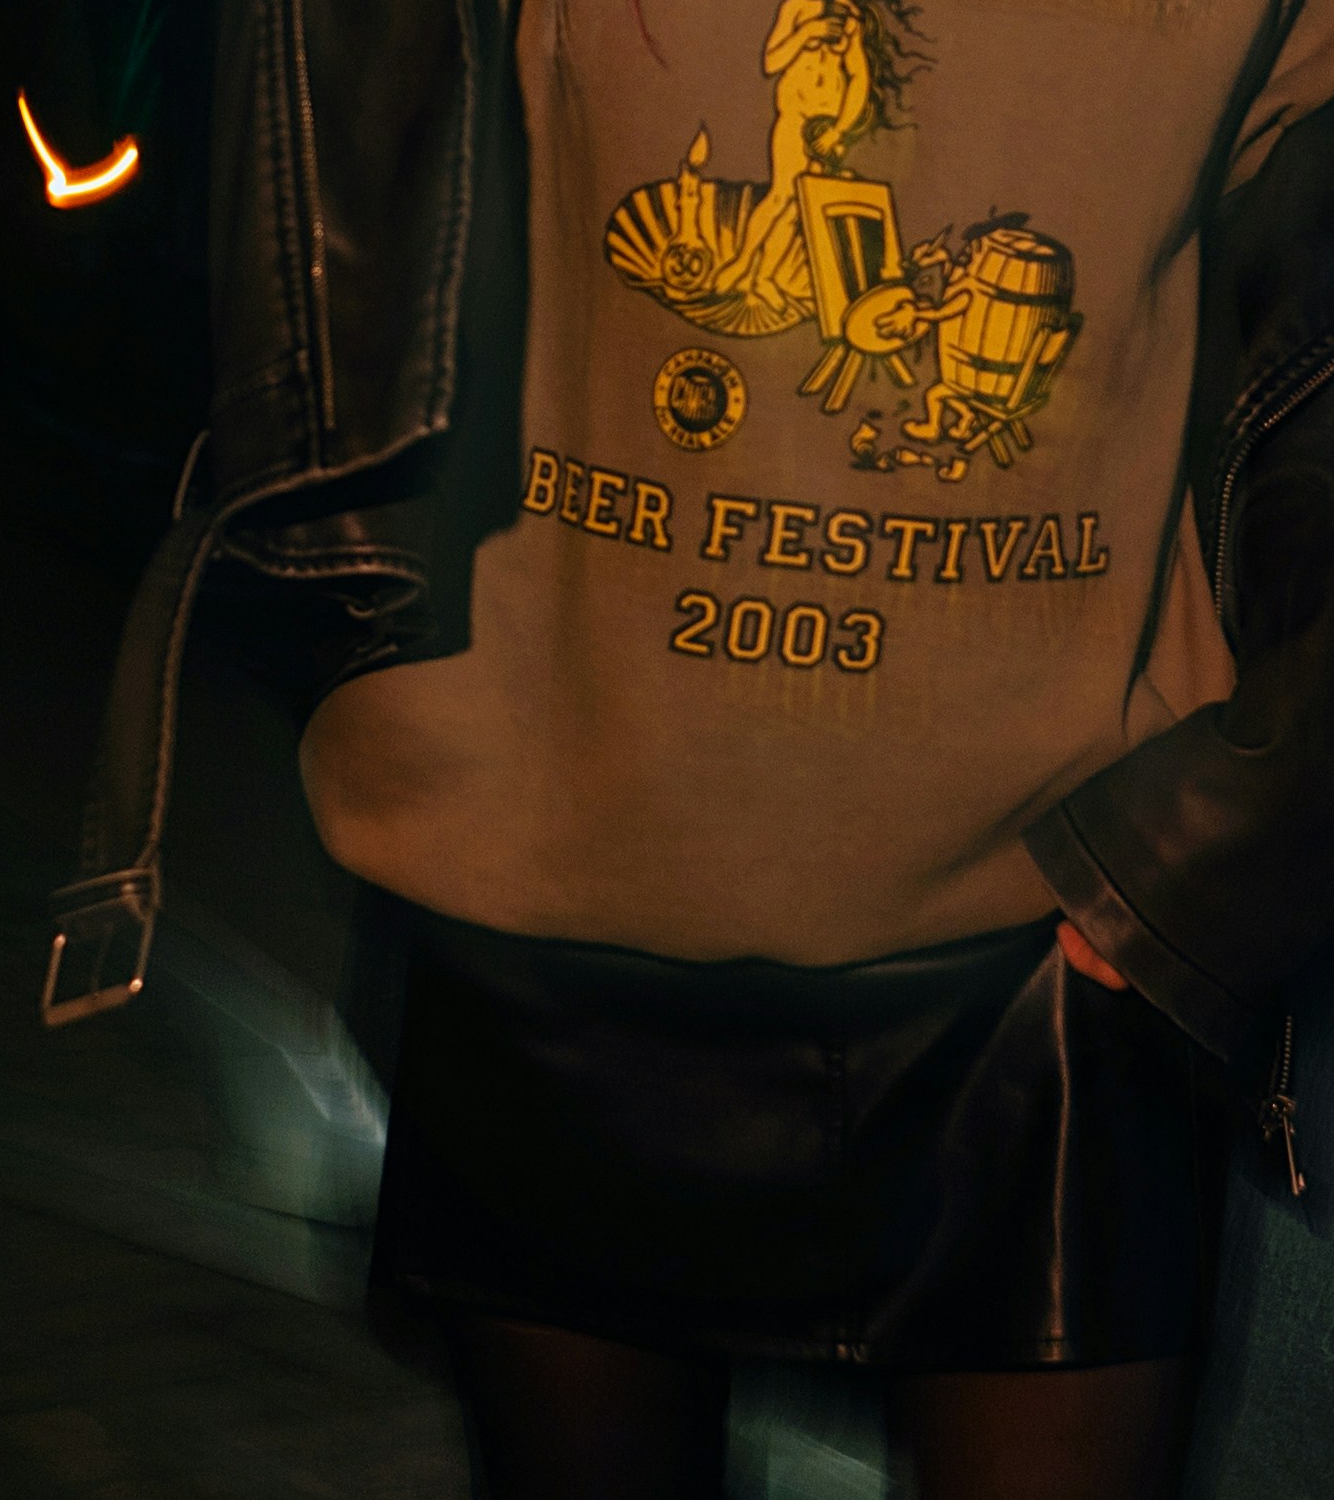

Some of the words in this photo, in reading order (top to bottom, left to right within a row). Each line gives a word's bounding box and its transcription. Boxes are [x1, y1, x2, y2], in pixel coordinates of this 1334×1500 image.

[668, 243, 705, 277] 30
[523, 447, 672, 550] BEER
[701, 492, 1110, 585] FESTIVAL
[671, 587, 885, 673] 2003
